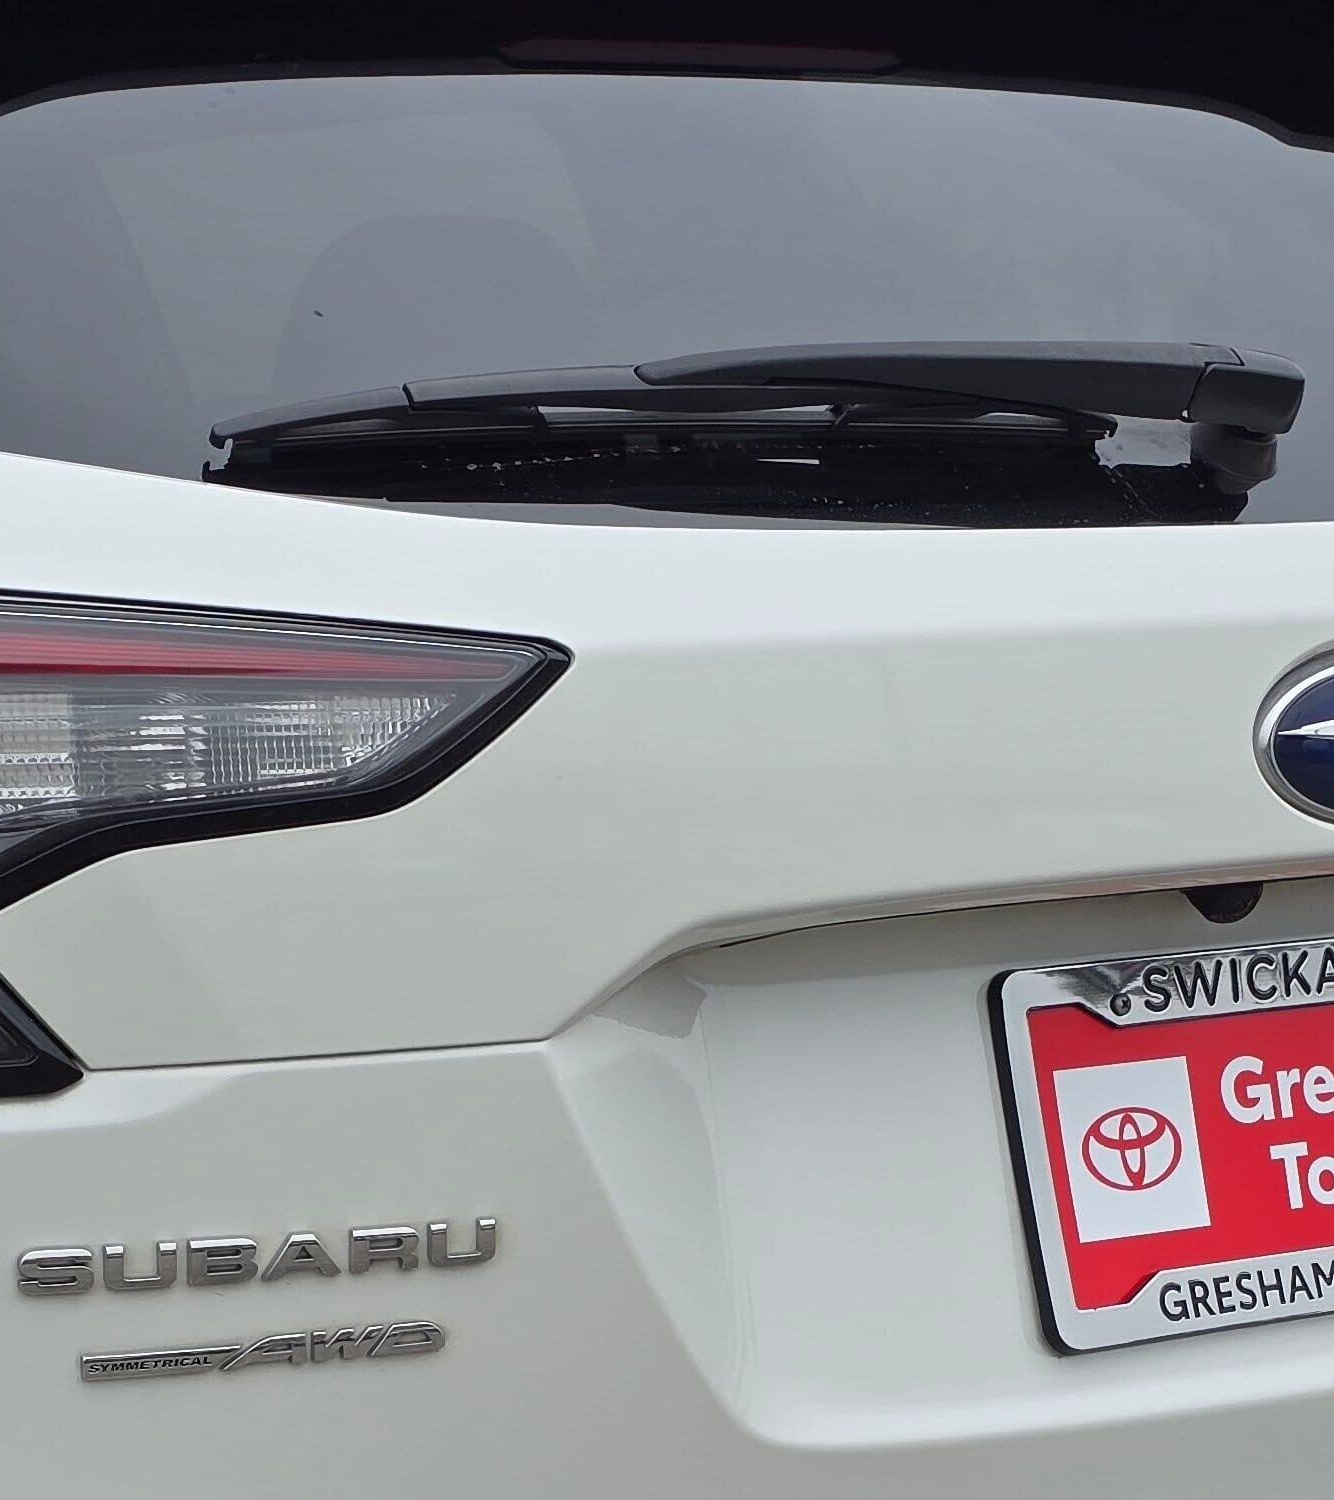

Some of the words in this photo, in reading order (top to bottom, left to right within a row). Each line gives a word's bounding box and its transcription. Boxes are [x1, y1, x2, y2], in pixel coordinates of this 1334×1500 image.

[17, 1216, 497, 1295] SUBARU
[87, 1354, 213, 1375] SYMMETRICAL
[220, 1319, 446, 1372] AWD
